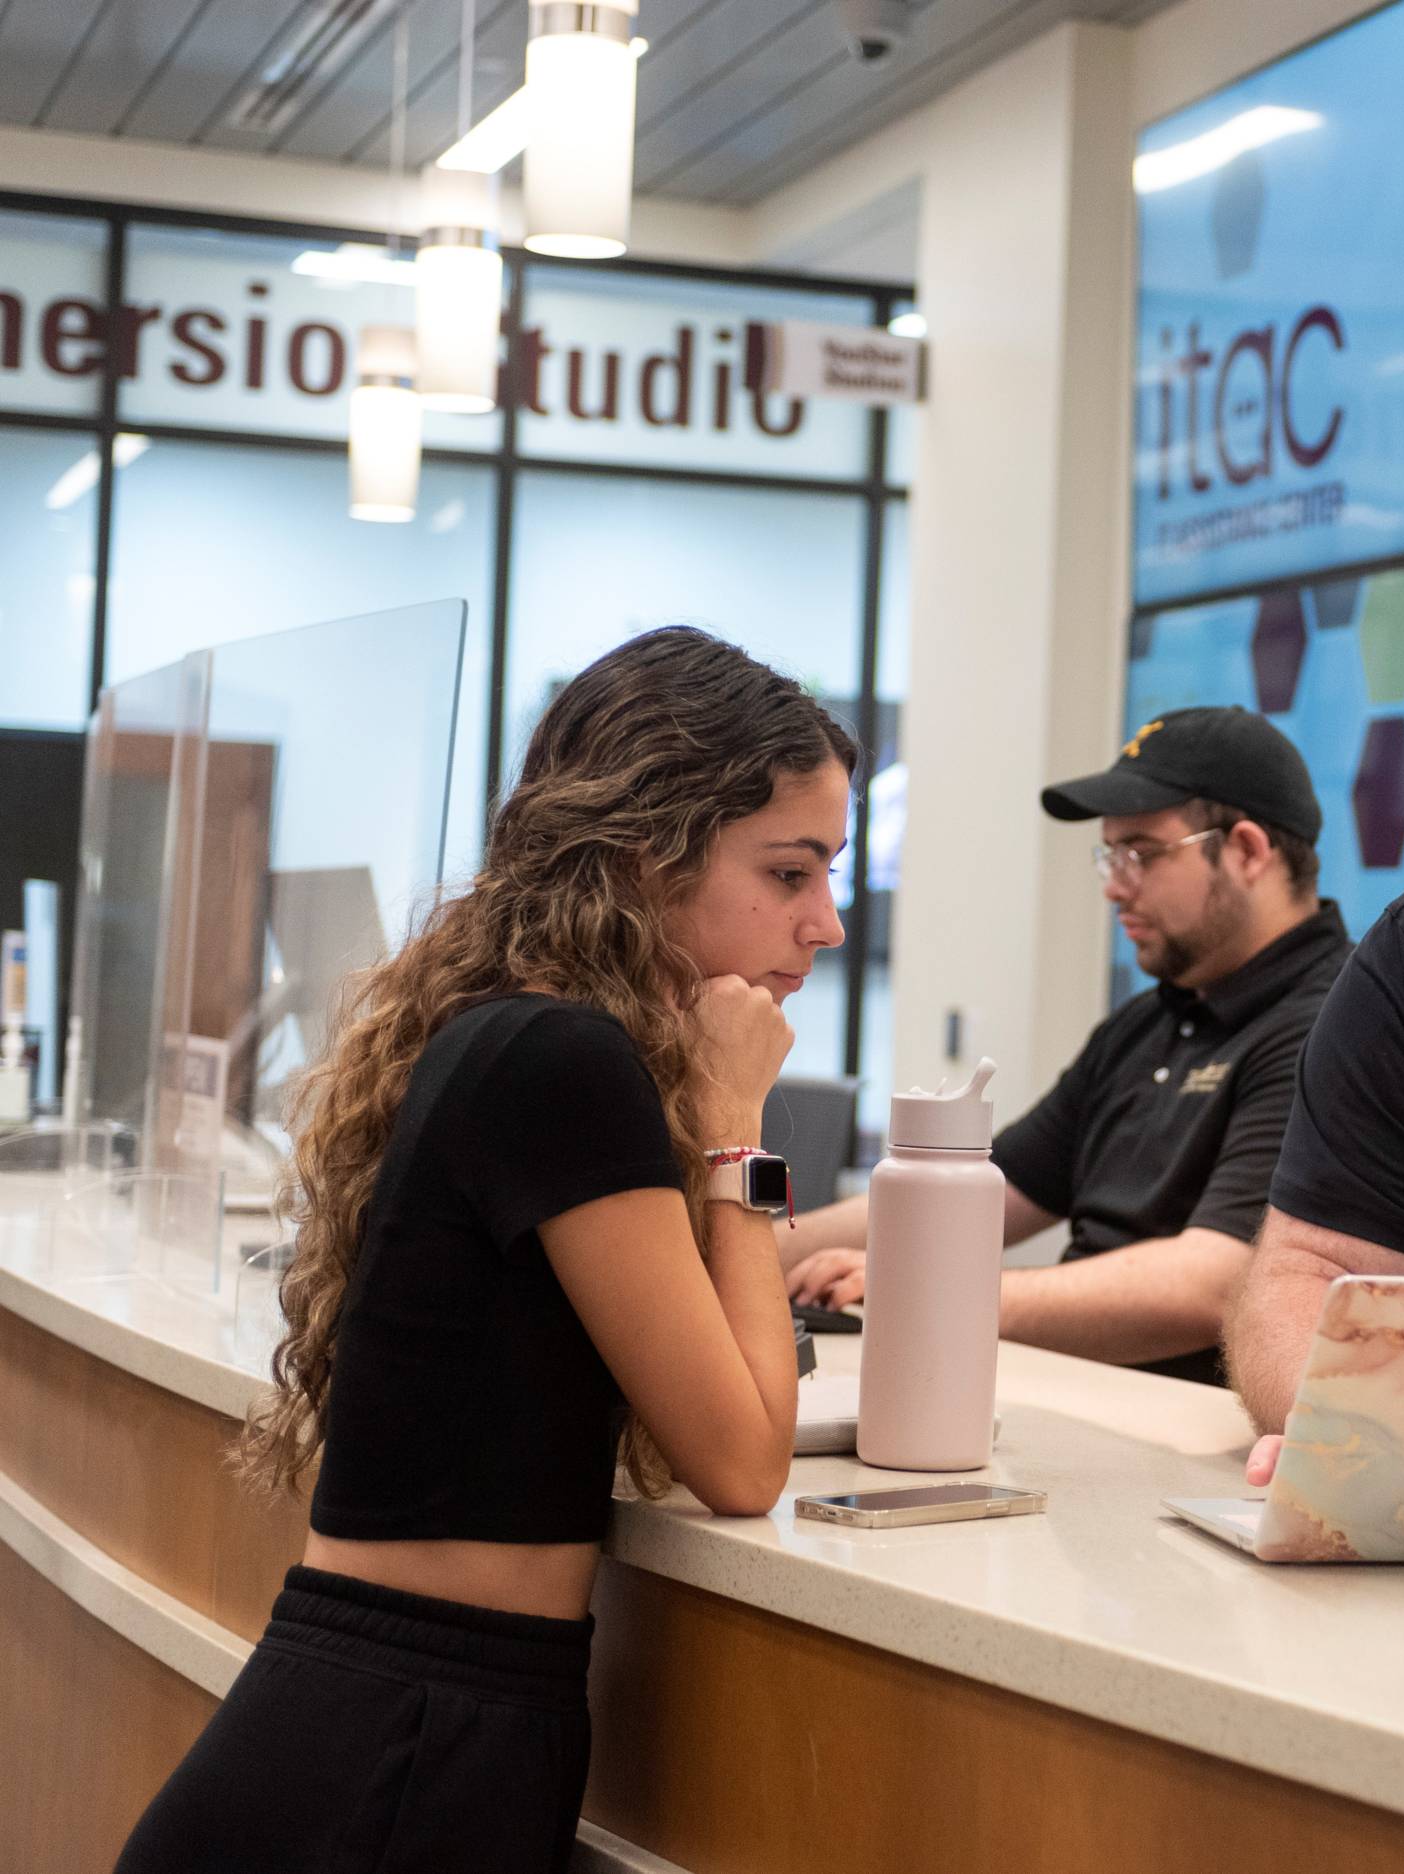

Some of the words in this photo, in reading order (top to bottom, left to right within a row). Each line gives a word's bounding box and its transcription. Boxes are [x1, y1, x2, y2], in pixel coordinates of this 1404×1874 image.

[0, 280, 348, 396] ersio
[497, 312, 803, 437] tudio
[1157, 305, 1344, 499] itac
